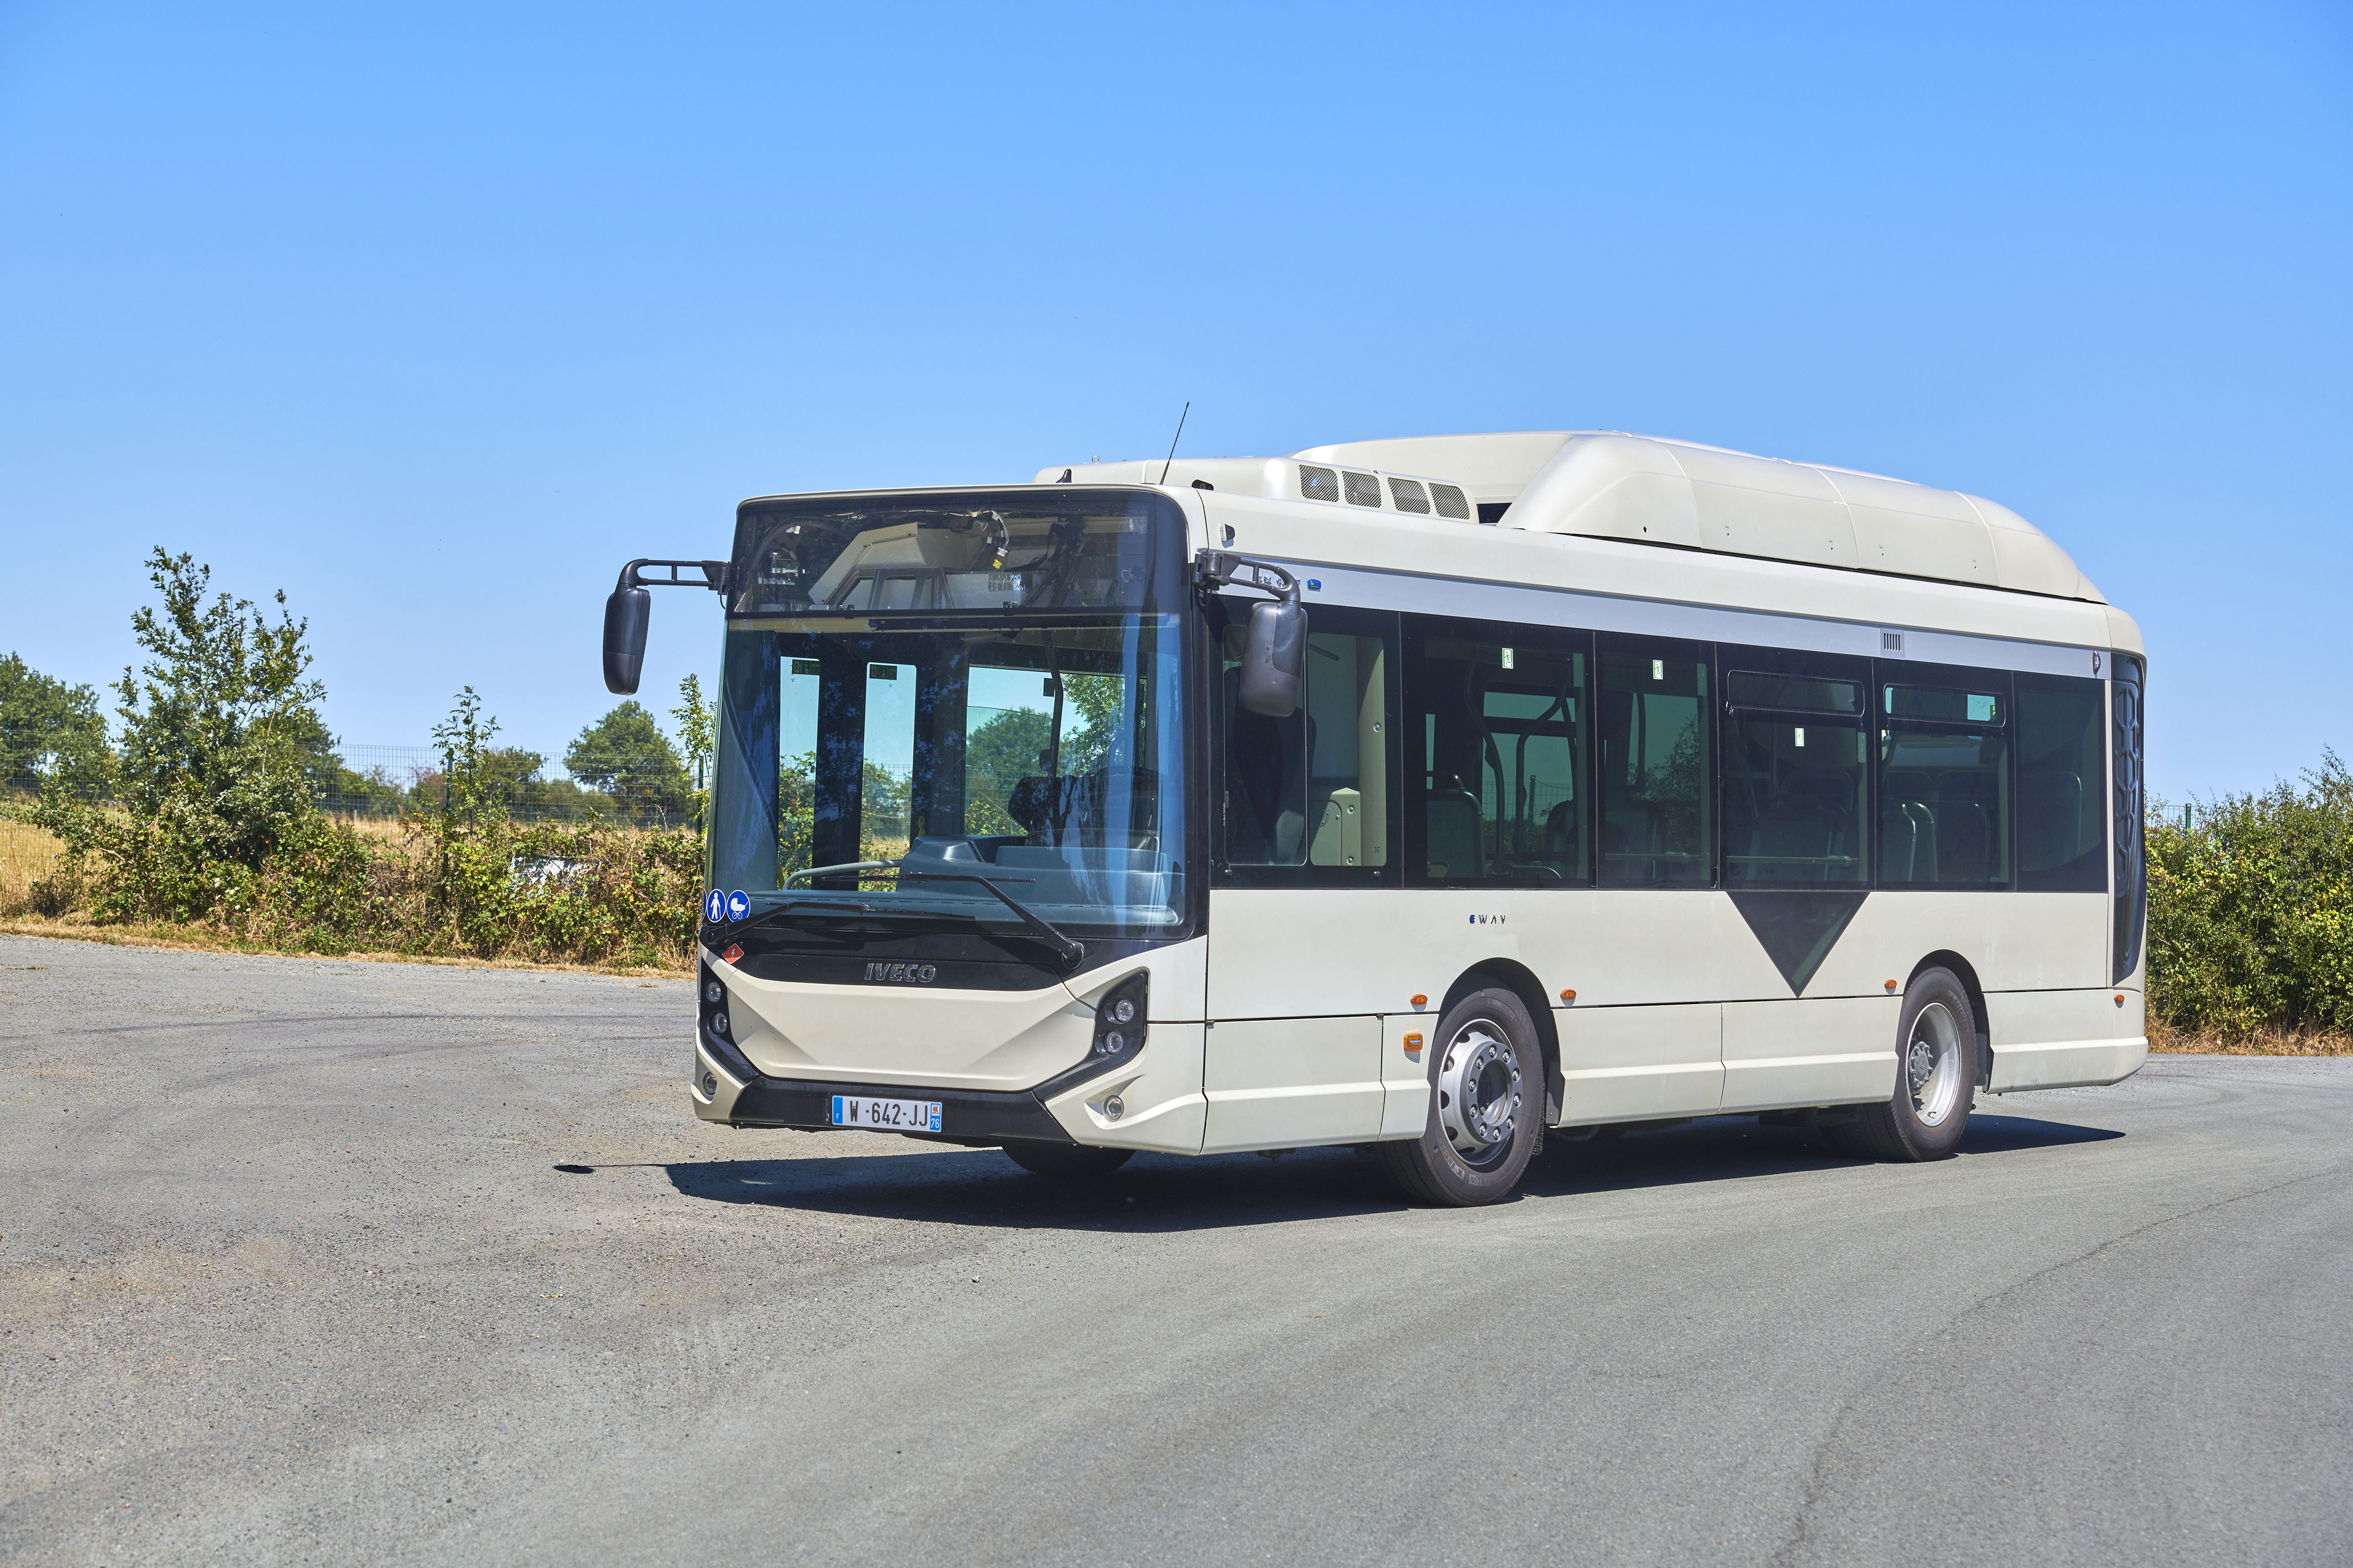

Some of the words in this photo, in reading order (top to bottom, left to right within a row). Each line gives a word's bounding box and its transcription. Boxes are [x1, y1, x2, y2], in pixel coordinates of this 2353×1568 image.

[1469, 914, 1506, 925] EWAY
[864, 963, 935, 983] IVECO
[931, 1118, 940, 1128] 76
